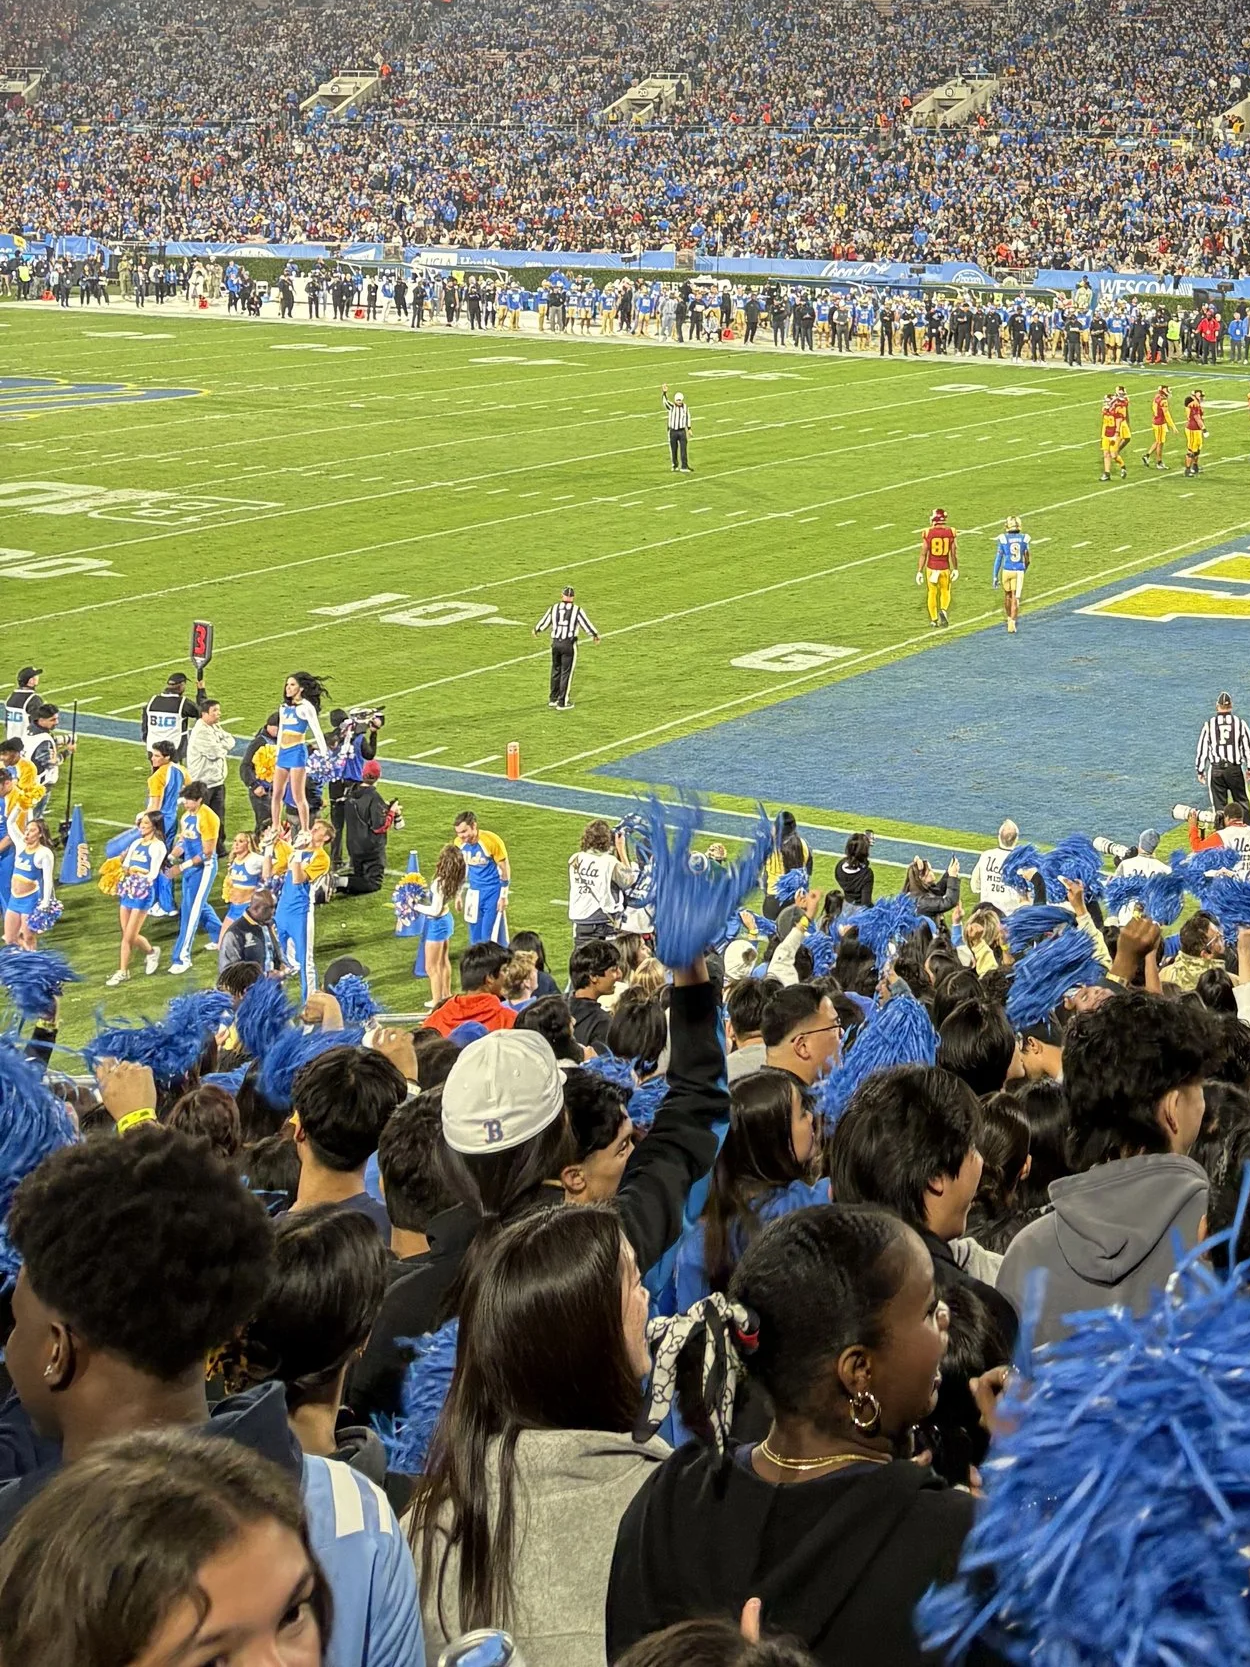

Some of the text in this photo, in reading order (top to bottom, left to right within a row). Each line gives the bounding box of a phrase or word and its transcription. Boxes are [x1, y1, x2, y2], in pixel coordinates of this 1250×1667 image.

[1100, 278, 1176, 296] WESCOM
[930, 537, 949, 556] 81
[1010, 542, 1021, 562] 9
[558, 609, 569, 626] L
[194, 625, 206, 656] 3
[730, 641, 862, 672] G
[1219, 725, 1232, 745] F
[462, 850, 488, 866] Ucla
[482, 1118, 504, 1144] B
